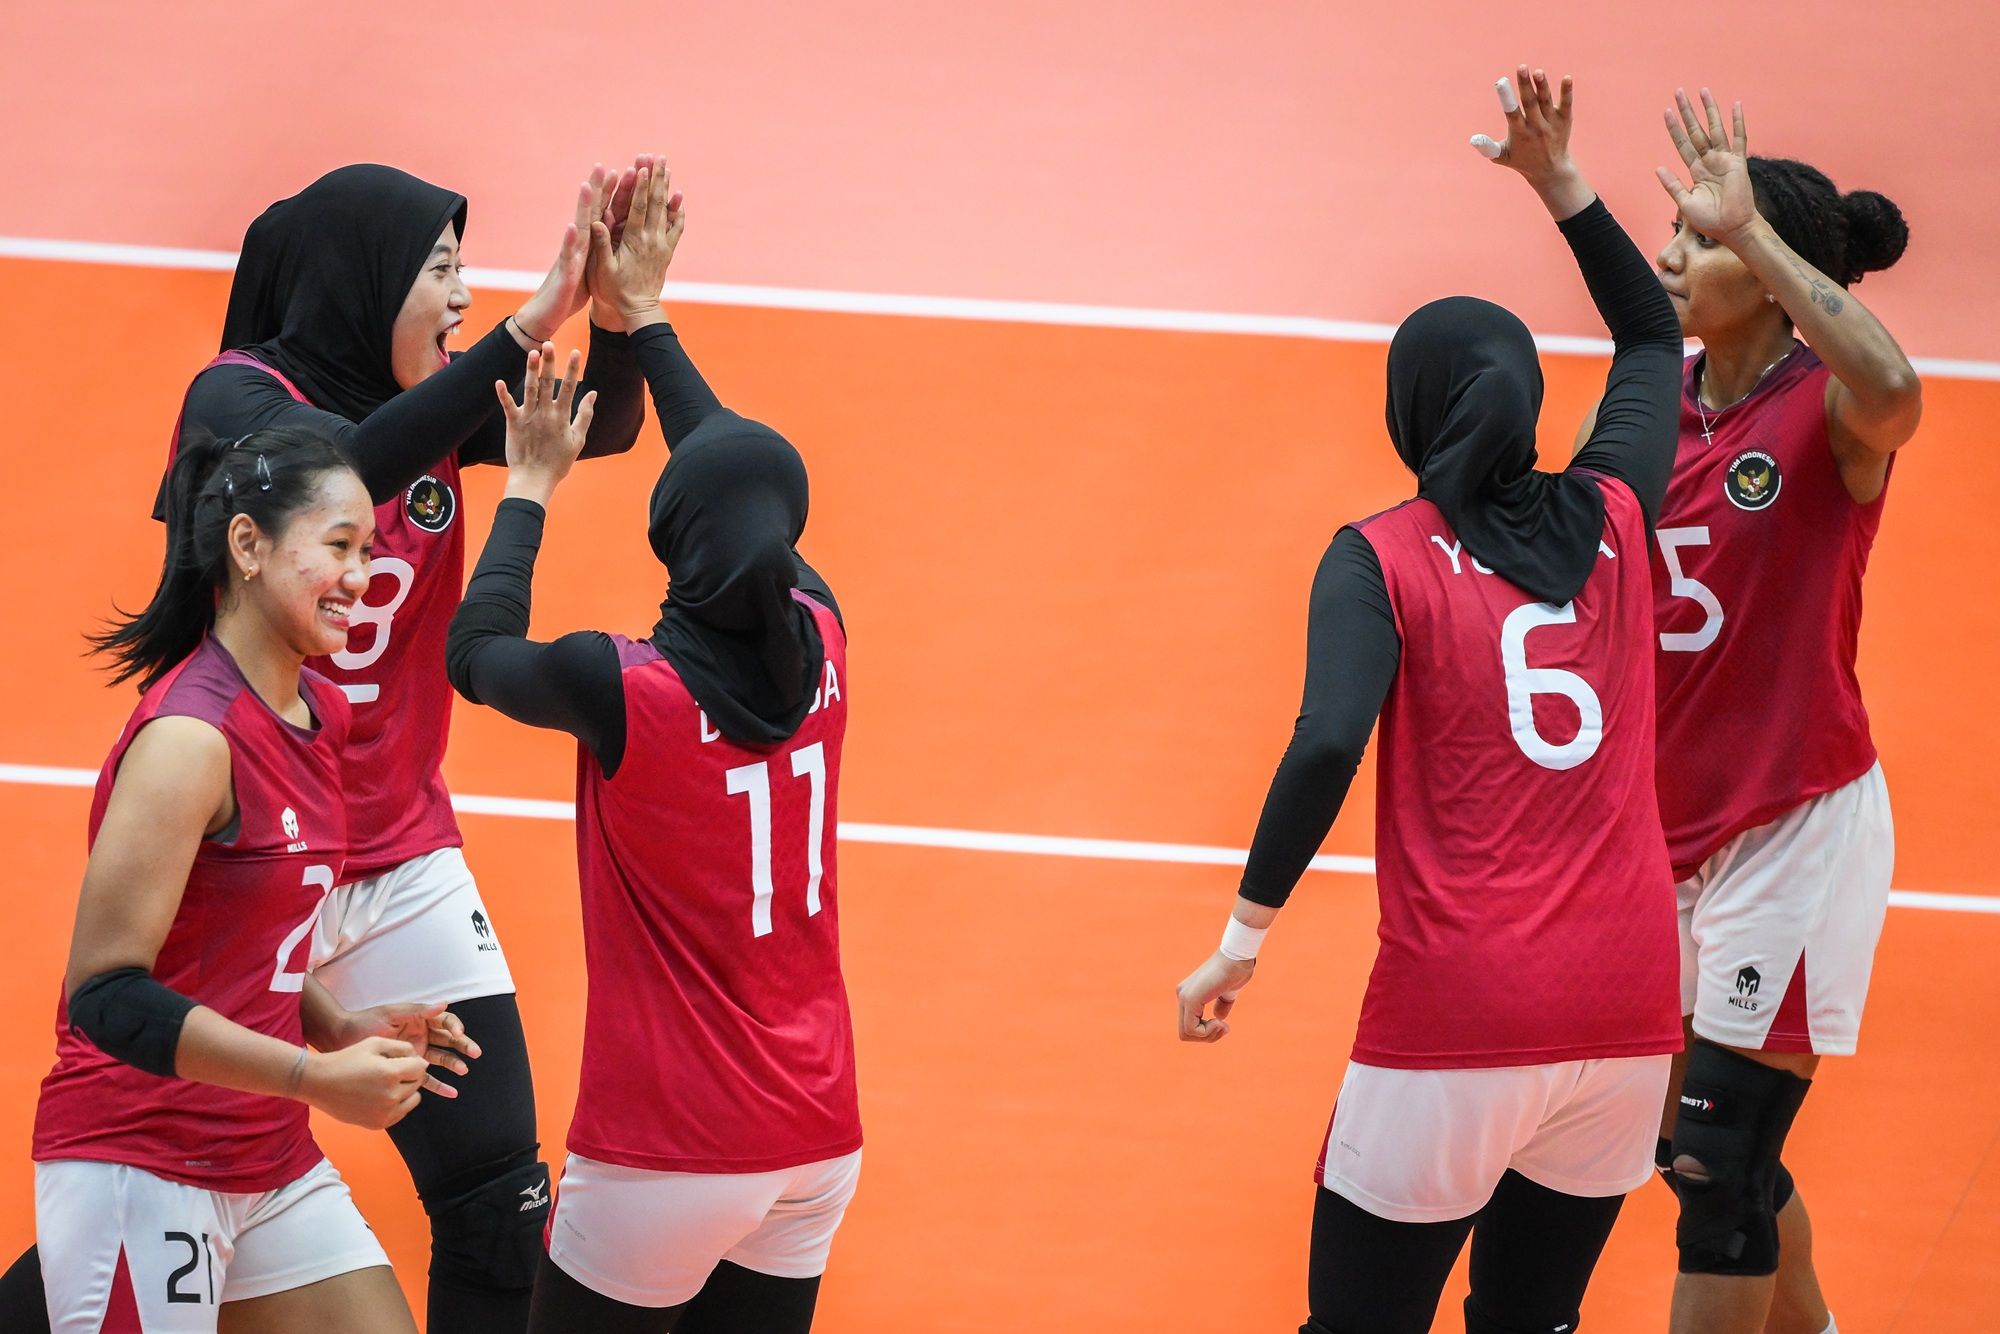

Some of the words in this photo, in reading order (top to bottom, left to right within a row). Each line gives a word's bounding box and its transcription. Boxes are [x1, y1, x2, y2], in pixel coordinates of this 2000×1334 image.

[1728, 459, 1741, 473] TIM
[1739, 451, 1776, 468] INDONESIA
[1656, 526, 1725, 652] 5
[1500, 600, 1603, 771] 6
[725, 741, 826, 939] 11
[269, 864, 345, 993] 2
[477, 942, 498, 952] MILLS
[1728, 996, 1758, 1011] MILLS
